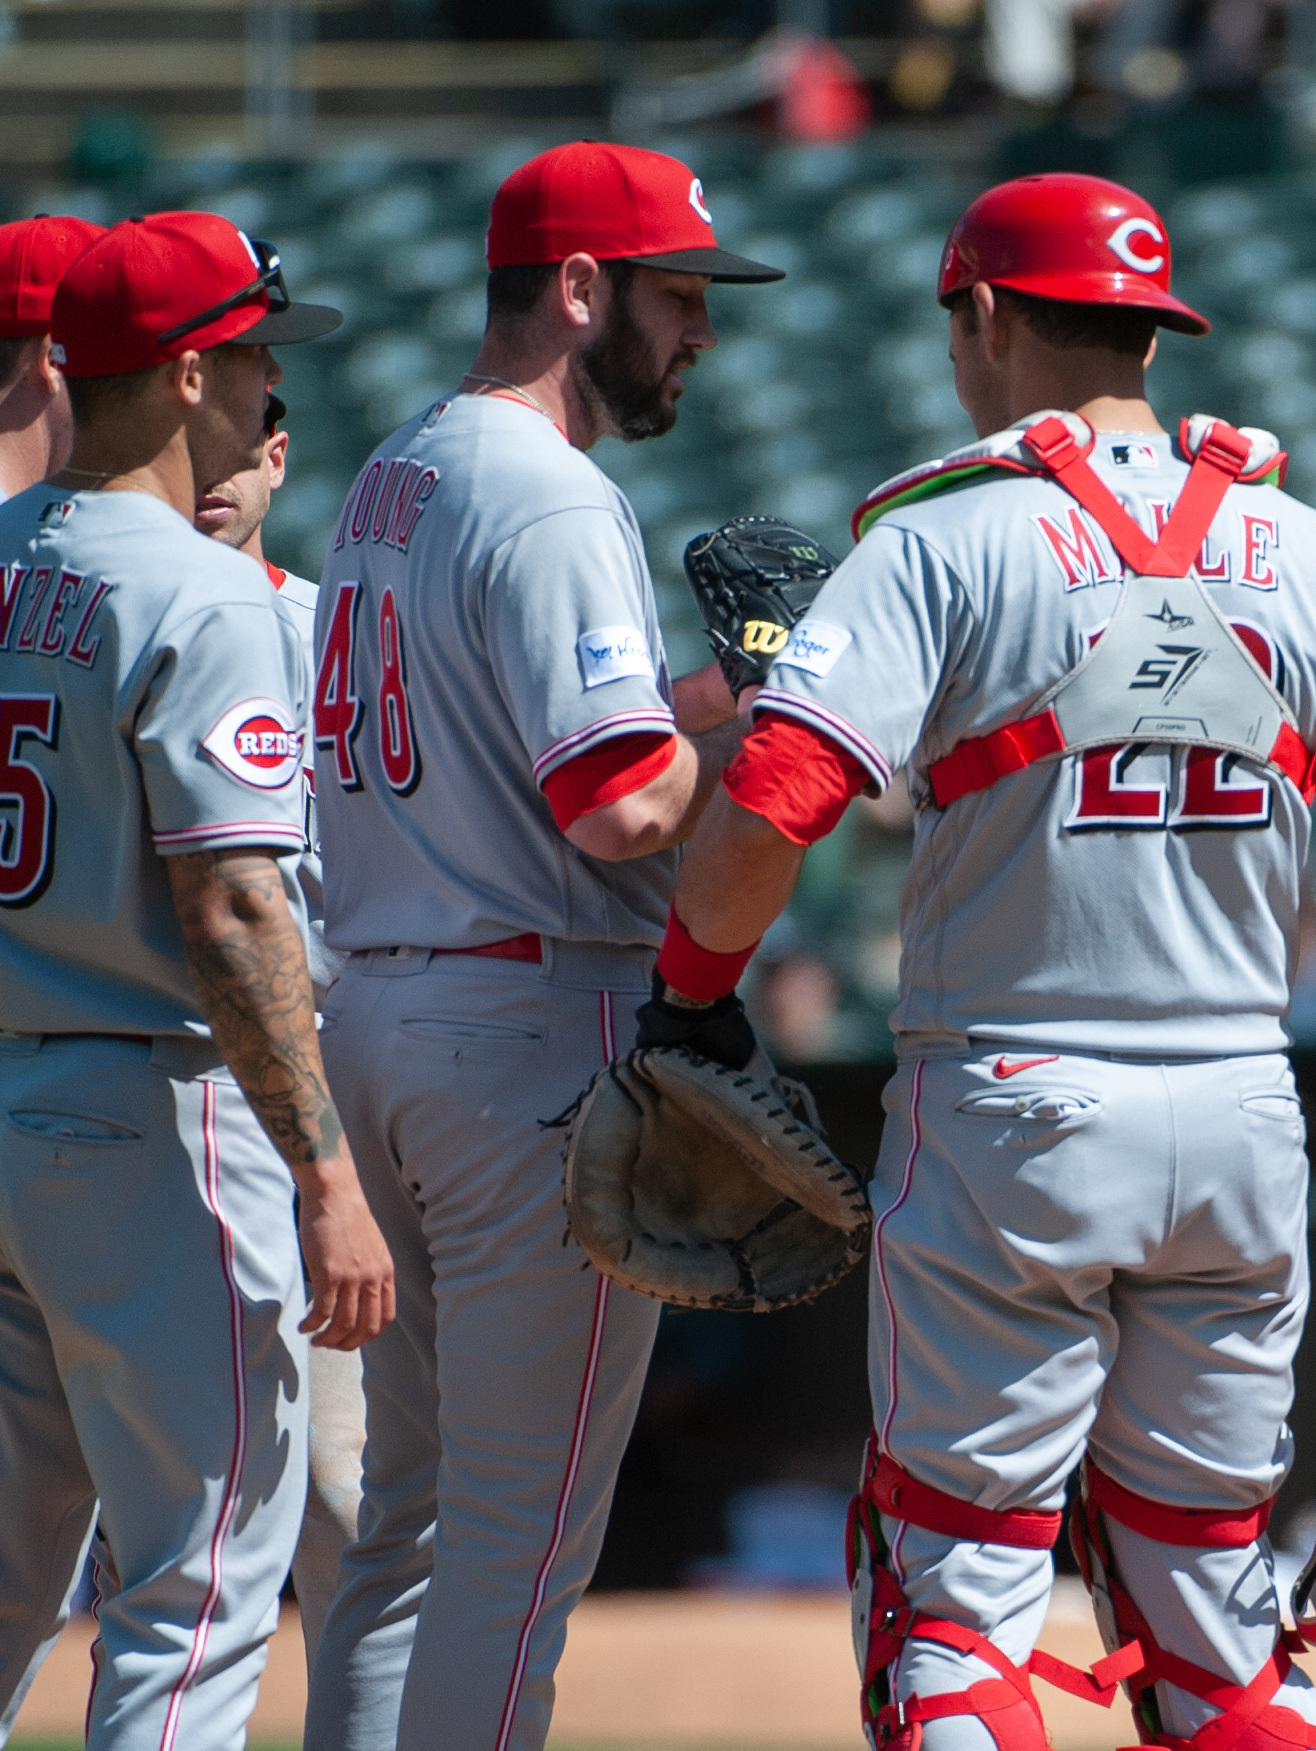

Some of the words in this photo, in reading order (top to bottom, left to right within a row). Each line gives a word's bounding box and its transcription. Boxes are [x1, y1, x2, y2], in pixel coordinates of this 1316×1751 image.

[1105, 217, 1165, 276] C
[1029, 497, 1280, 593] MLE
[313, 580, 422, 798] 48
[237, 731, 301, 757] REDS
[0, 692, 59, 911] 5
